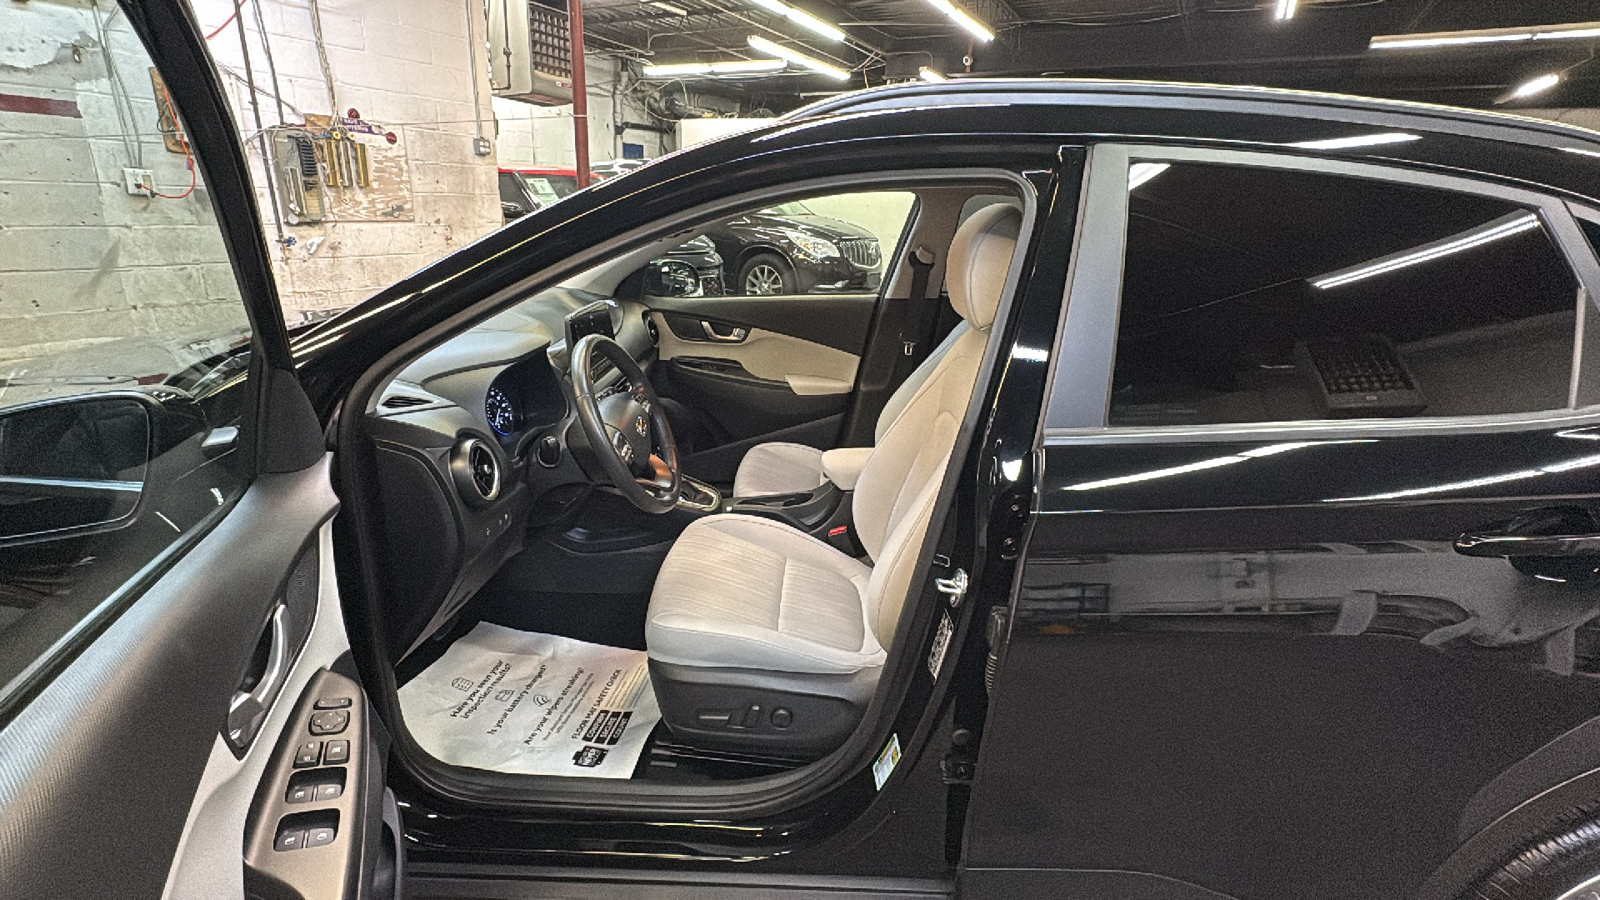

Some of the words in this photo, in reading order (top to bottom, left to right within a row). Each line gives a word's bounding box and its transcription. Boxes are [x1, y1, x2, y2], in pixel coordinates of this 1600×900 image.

[450, 702, 468, 717] Have
[466, 689, 480, 702] you
[477, 675, 492, 688] seen
[490, 660, 503, 675] your
[460, 686, 493, 718] inspection
[491, 663, 512, 686] results?
[493, 712, 509, 728] your
[504, 690, 528, 712] battery
[525, 665, 547, 690] charged?
[524, 733, 537, 745] Are
[534, 717, 548, 732] your
[545, 697, 564, 716] wipers
[561, 667, 584, 696] streaking?
[572, 720, 591, 739] FLOOR
[585, 706, 598, 719] MAT
[594, 685, 610, 708] SAFETY
[606, 669, 622, 687] CHECK
[587, 711, 606, 738] CONFIRM
[600, 717, 617, 738] SECURE
[613, 718, 629, 739] COUNT
